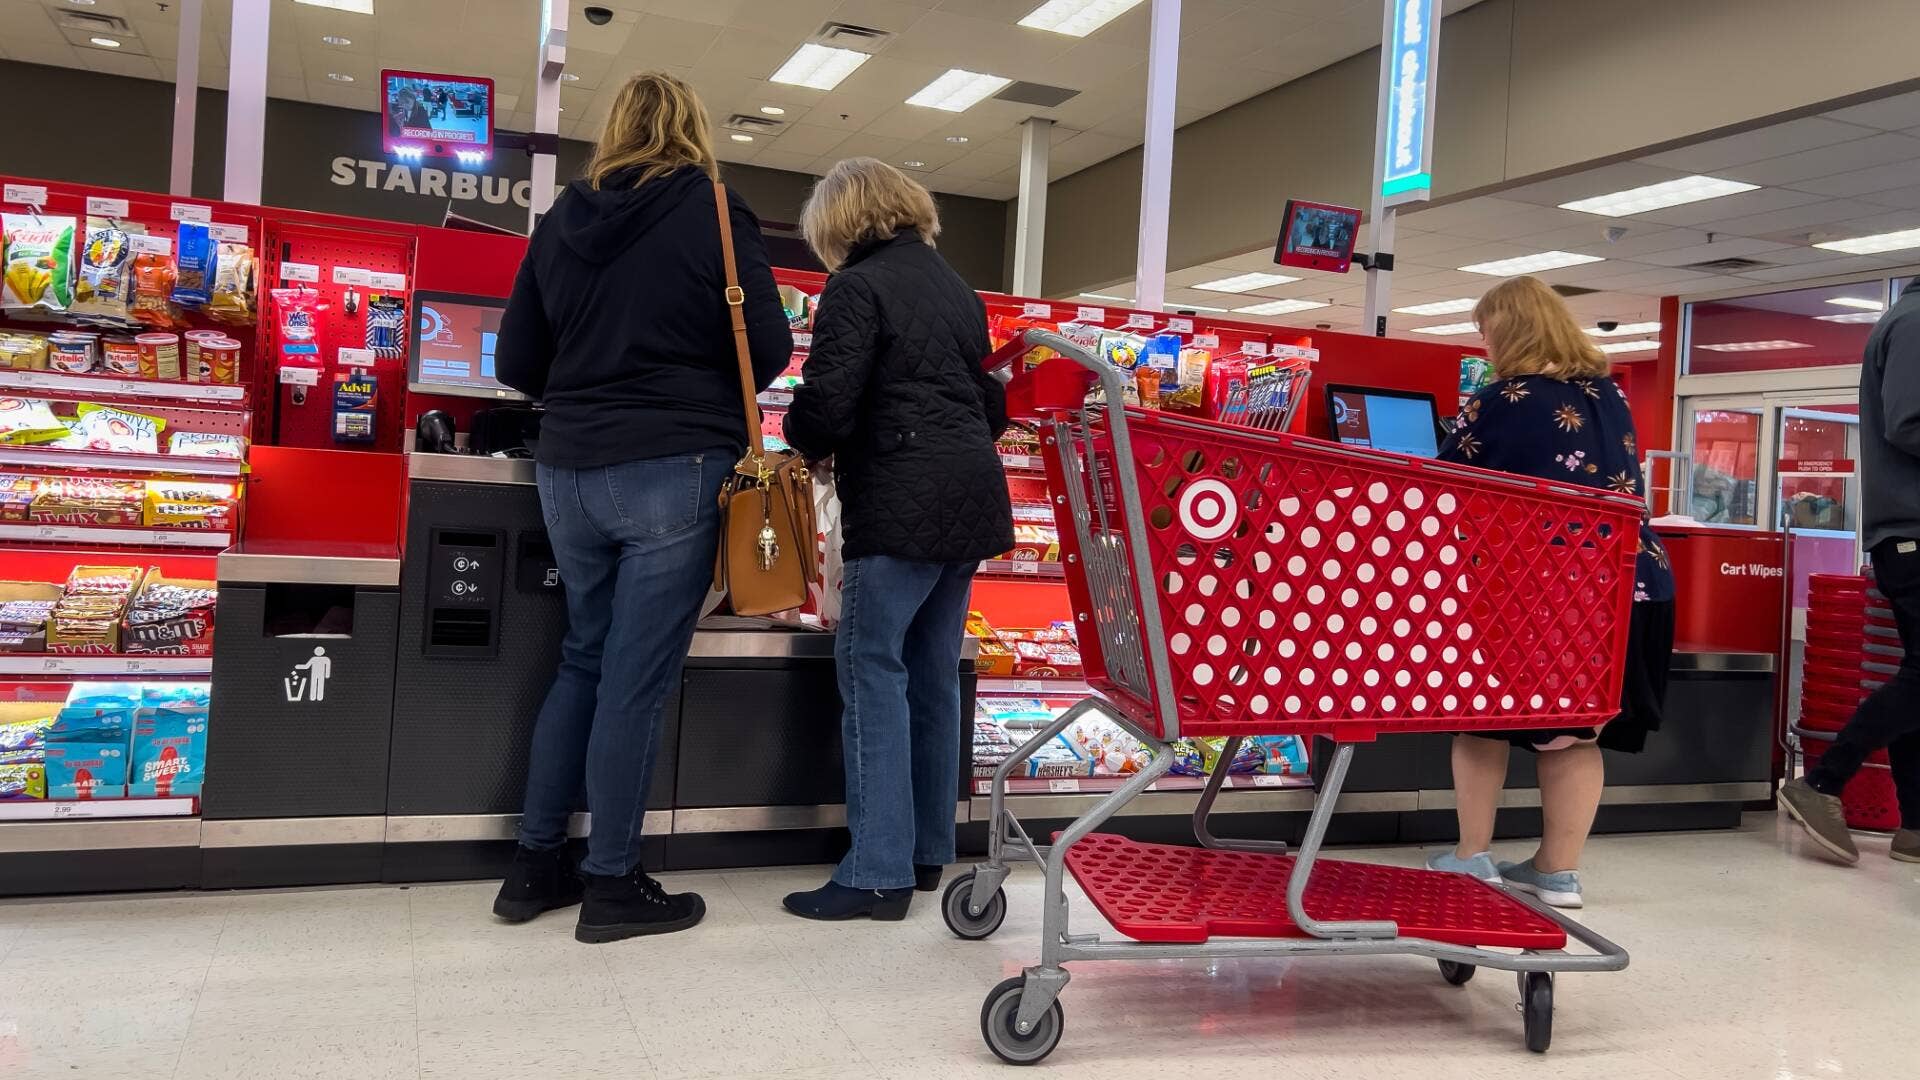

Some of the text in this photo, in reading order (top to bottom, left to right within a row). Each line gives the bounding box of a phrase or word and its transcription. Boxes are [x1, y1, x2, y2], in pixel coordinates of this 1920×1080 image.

[403, 129, 438, 138] RECORDING
[445, 131, 474, 140] PROGRESS
[330, 156, 566, 208] STARBUC
[288, 311, 307, 321] Wet
[288, 319, 309, 328] Ones
[52, 353, 85, 364] nutella
[339, 382, 372, 393] Advil
[1720, 562, 1784, 579] Cart Wipes
[144, 756, 188, 773] SMART
[142, 763, 192, 783] SWEETS
[1038, 765, 1074, 777] HERSHEY'S
